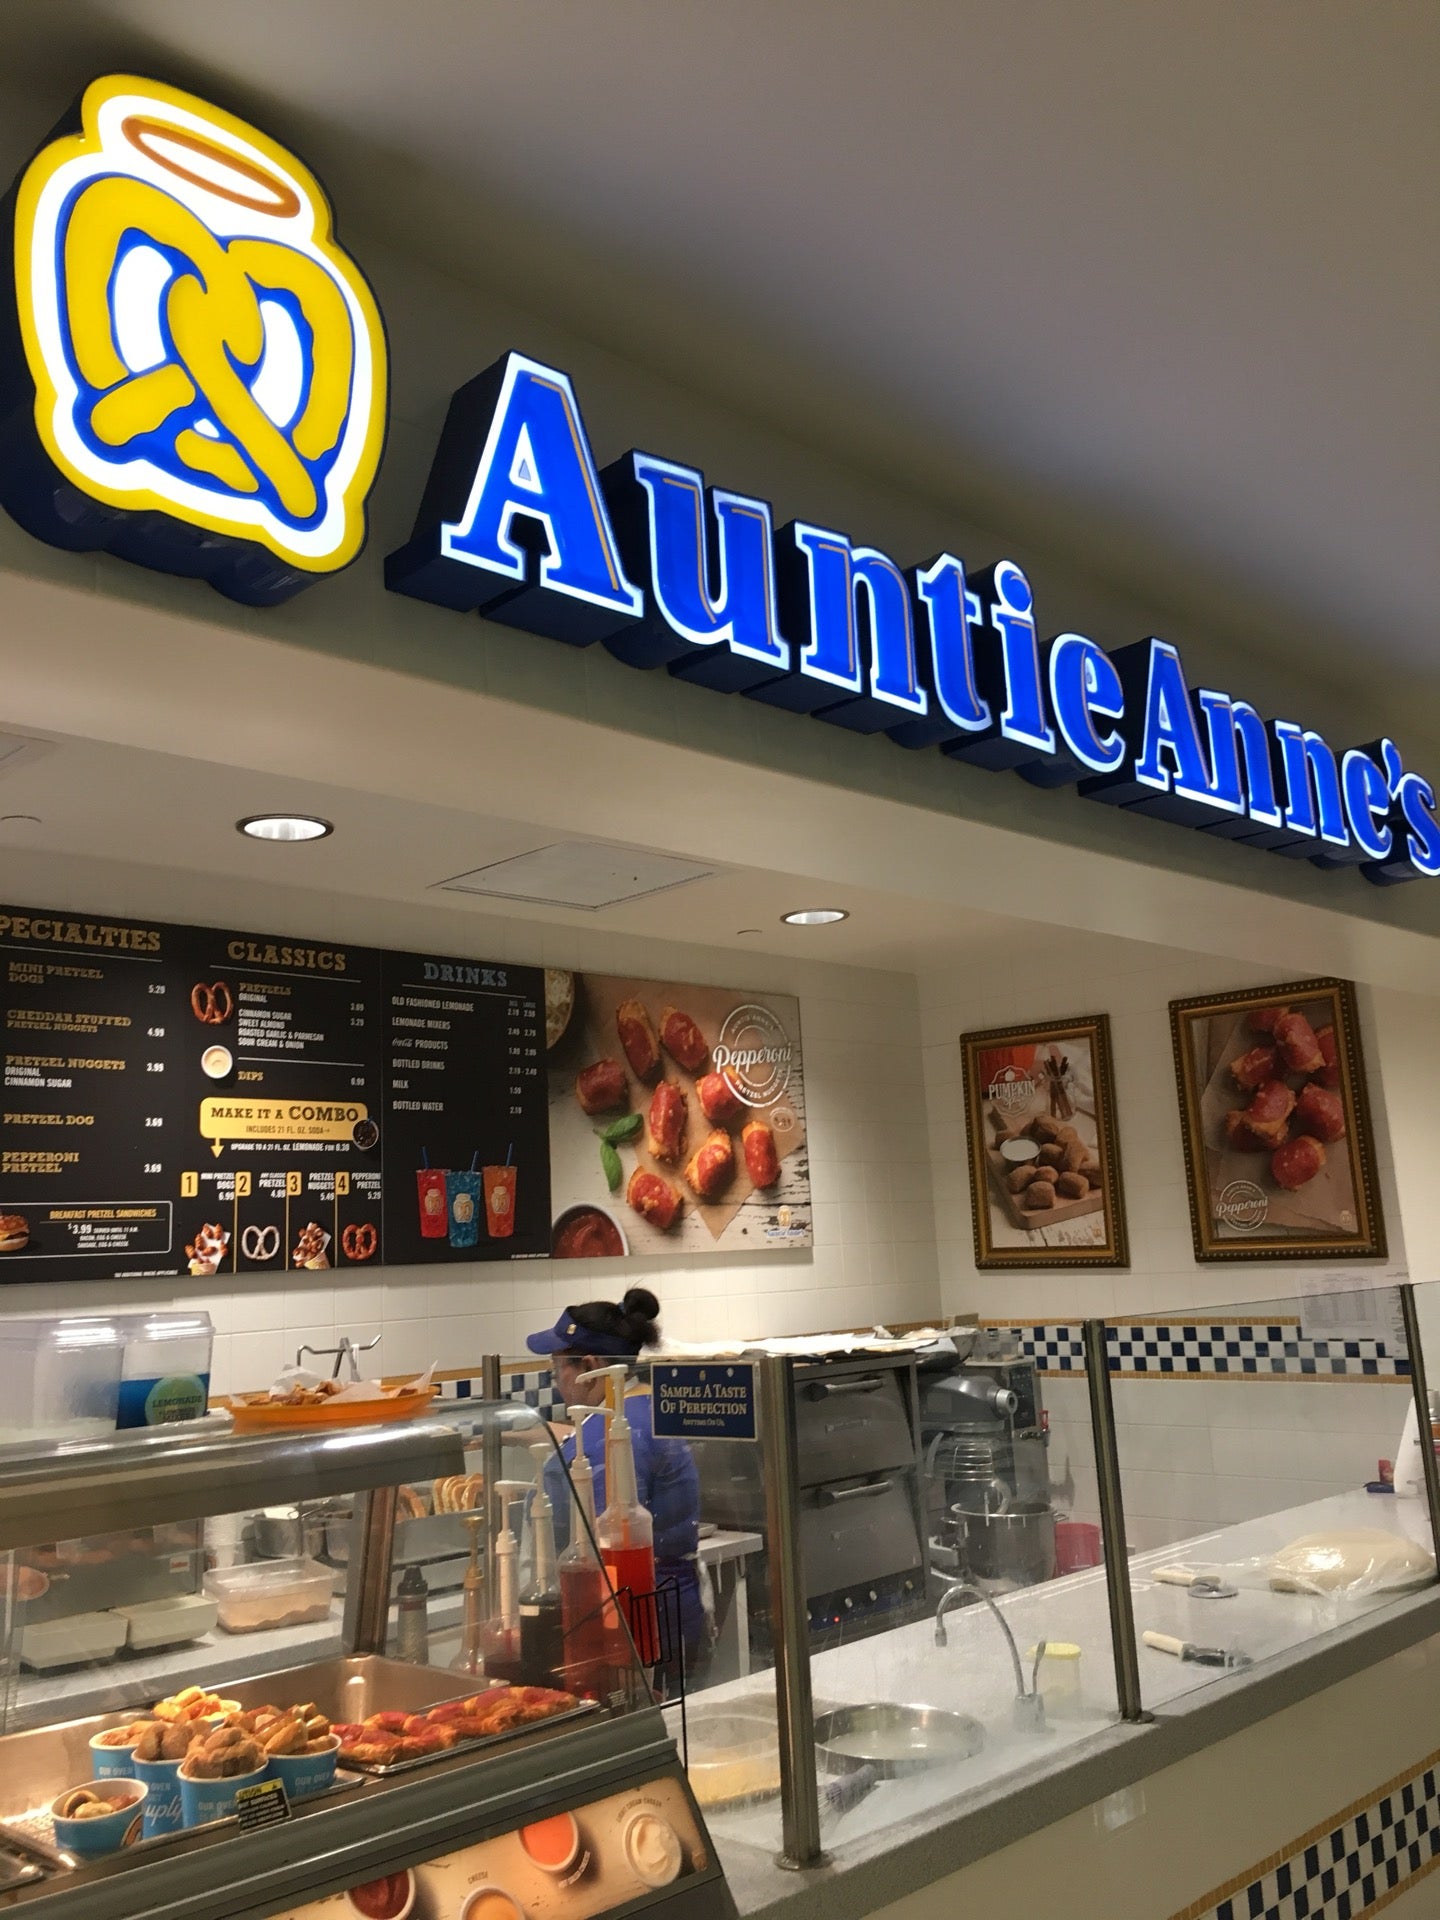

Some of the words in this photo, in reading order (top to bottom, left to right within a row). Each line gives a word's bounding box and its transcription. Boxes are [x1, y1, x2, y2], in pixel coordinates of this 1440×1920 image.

[441, 350, 1126, 774] Auntie
[1135, 637, 1440, 876] Anne's
[227, 941, 347, 971] CLASSICS
[9, 962, 43, 974] MINI
[47, 964, 104, 979] PRETZEL
[423, 962, 507, 987] DRINKS
[9, 973, 44, 984] DOGS
[239, 982, 292, 995] PRETZELS
[238, 992, 268, 1003] ORIGINAL
[392, 996, 405, 1006] OLD
[406, 997, 441, 1009] FASHIONED
[442, 1001, 474, 1012] LEMONADE
[7, 1010, 73, 1023] CHEDDAR
[75, 1014, 132, 1027] STUFFED
[238, 1009, 271, 1019] CINNAMON
[272, 1011, 292, 1020] SUGAR
[7, 1020, 52, 1030] PRETZEL
[54, 1022, 98, 1033] NUGGETS
[238, 1018, 259, 1027] SWEET
[260, 1020, 285, 1029] ALMOND
[392, 1016, 426, 1028] LEMONADE
[427, 1019, 451, 1030] MIXERS
[147, 1028, 165, 1037] 4.99
[238, 1028, 265, 1037] ROASTED
[266, 1030, 287, 1039] GARLIC
[288, 1031, 293, 1039] &
[294, 1032, 324, 1041] PARMESAN
[238, 1037, 255, 1046] SOUR
[256, 1038, 278, 1047] CREAM
[279, 1040, 284, 1048] &
[285, 1040, 304, 1049] ONION
[415, 1039, 448, 1050] PRODUCTS
[5, 1055, 65, 1067] PRETZEL
[68, 1058, 126, 1070] NUGGETS
[392, 1058, 420, 1069] BOTTLED
[421, 1060, 445, 1070] DRINKS
[712, 1042, 792, 1074] Pepperoni
[5, 1067, 41, 1077] ORIGINAL
[146, 1062, 164, 1072] 3.99
[238, 1071, 264, 1081] DIPS
[4, 1077, 45, 1088] CINNAMON
[47, 1079, 72, 1088] SUGAR
[392, 1079, 409, 1089] MILK
[735, 1080, 761, 1099] PRETZEL
[988, 1080, 1035, 1100] PUMPKIN
[392, 1100, 420, 1110] BOTTLED
[421, 1101, 444, 1111] WATER
[3, 1113, 64, 1125] PRETZEL
[66, 1115, 95, 1125] DOG
[211, 1107, 253, 1119] MAKE
[257, 1108, 271, 1119] IT
[275, 1109, 283, 1119] A
[288, 1105, 359, 1122] COMBO
[246, 1125, 276, 1134] INCLUDES
[277, 1126, 284, 1134] 21
[287, 1126, 296, 1134] FL.
[231, 1143, 255, 1151] UPGRADE
[292, 1143, 324, 1151] LEMONADE
[2, 1152, 80, 1162] PEPPERONI
[2, 1163, 63, 1173] PRETZEL
[214, 1172, 235, 1180] PRETZEL
[309, 1172, 334, 1181] PRETZEL
[351, 1172, 381, 1180] PEPPERONI
[217, 1180, 235, 1190] DOGS
[239, 1175, 247, 1193] 2
[259, 1179, 286, 1188] PRETZEL
[290, 1175, 298, 1192] 3
[308, 1182, 334, 1190] NUGGETS
[338, 1175, 346, 1191] 4
[356, 1181, 381, 1189] PRETZEL
[1216, 1196, 1268, 1217] Pepperoni
[50, 1210, 86, 1219] BREAKFAST
[87, 1209, 115, 1218] PRETZEL
[116, 1208, 157, 1218] SANDWICHES
[660, 1384, 701, 1399] SAMPLE
[704, 1384, 712, 1398] A
[713, 1384, 747, 1399] TASTE
[660, 1399, 676, 1414] OF
[679, 1400, 748, 1415] PERFECTION
[468, 1871, 488, 1884] CHEESE
